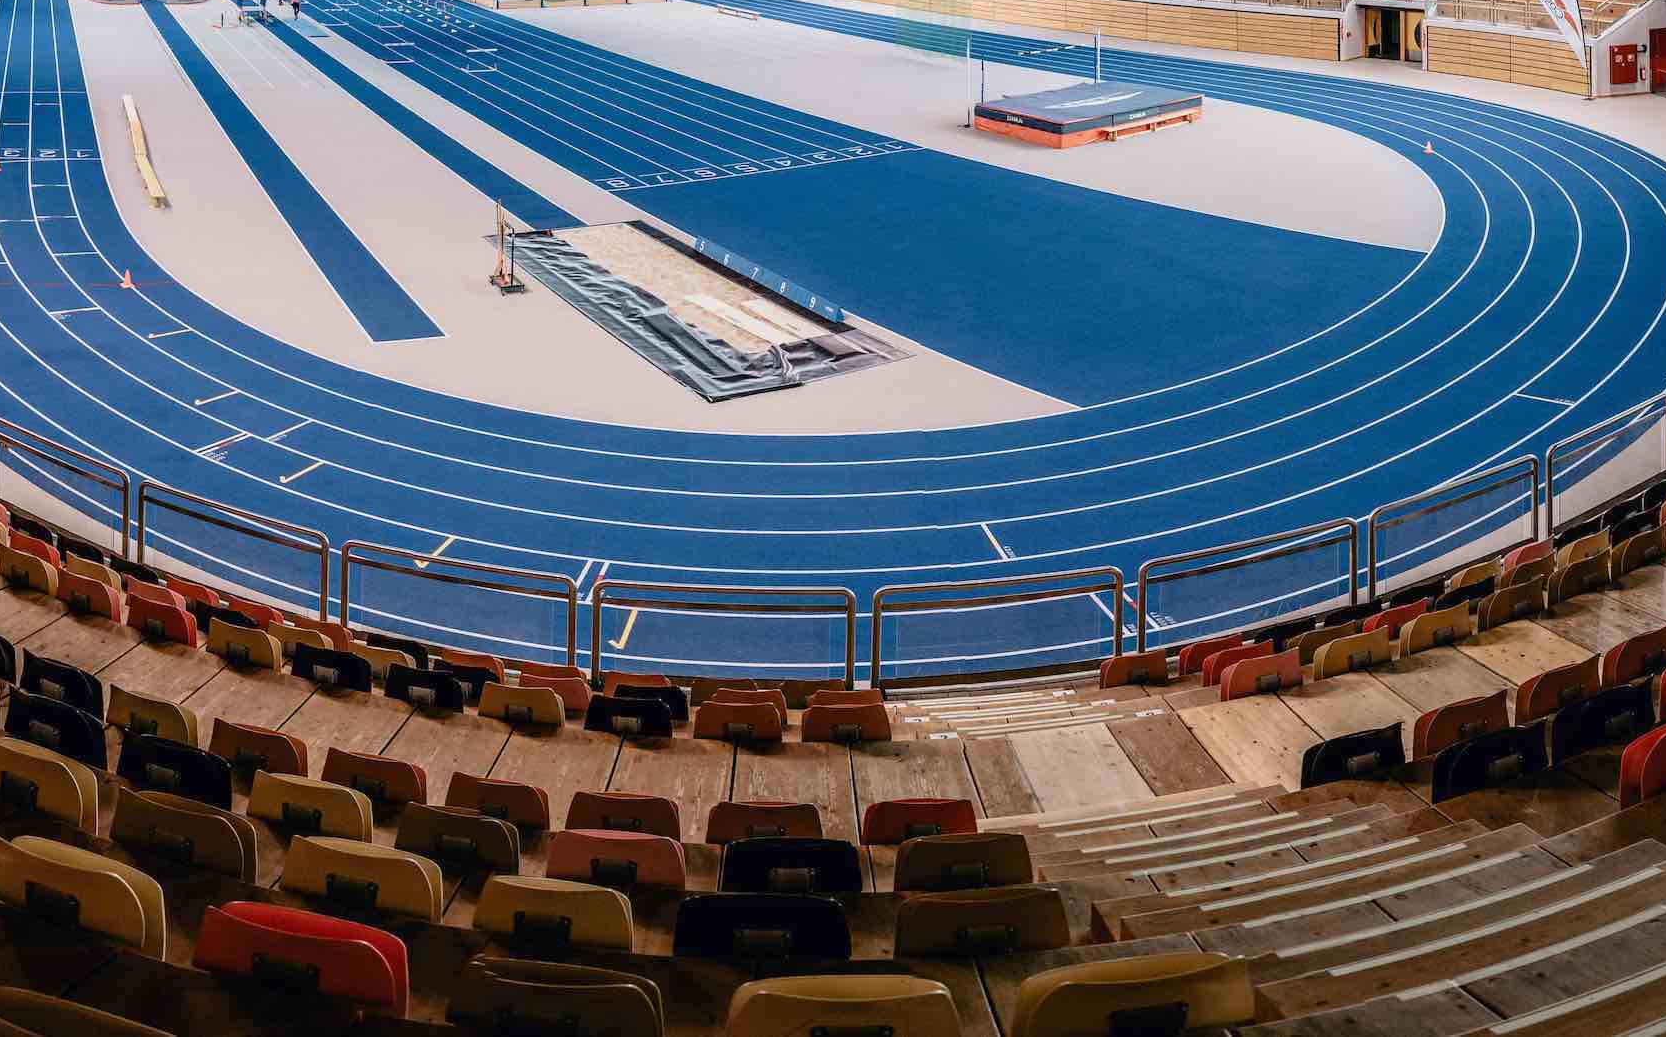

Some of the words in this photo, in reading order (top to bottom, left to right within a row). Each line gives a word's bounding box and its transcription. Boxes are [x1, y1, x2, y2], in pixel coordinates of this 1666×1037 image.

[39, 150, 56, 158] 2
[849, 147, 872, 156] 2
[813, 153, 835, 161] 3
[774, 159, 791, 167] 4
[734, 163, 758, 173] 5
[694, 169, 717, 178] 6
[657, 174, 674, 183] 7
[607, 179, 630, 188] 8
[699, 241, 705, 252] 5
[723, 253, 730, 265] 6
[751, 267, 759, 280] 7
[780, 281, 786, 294] 8
[809, 296, 816, 309] 9
